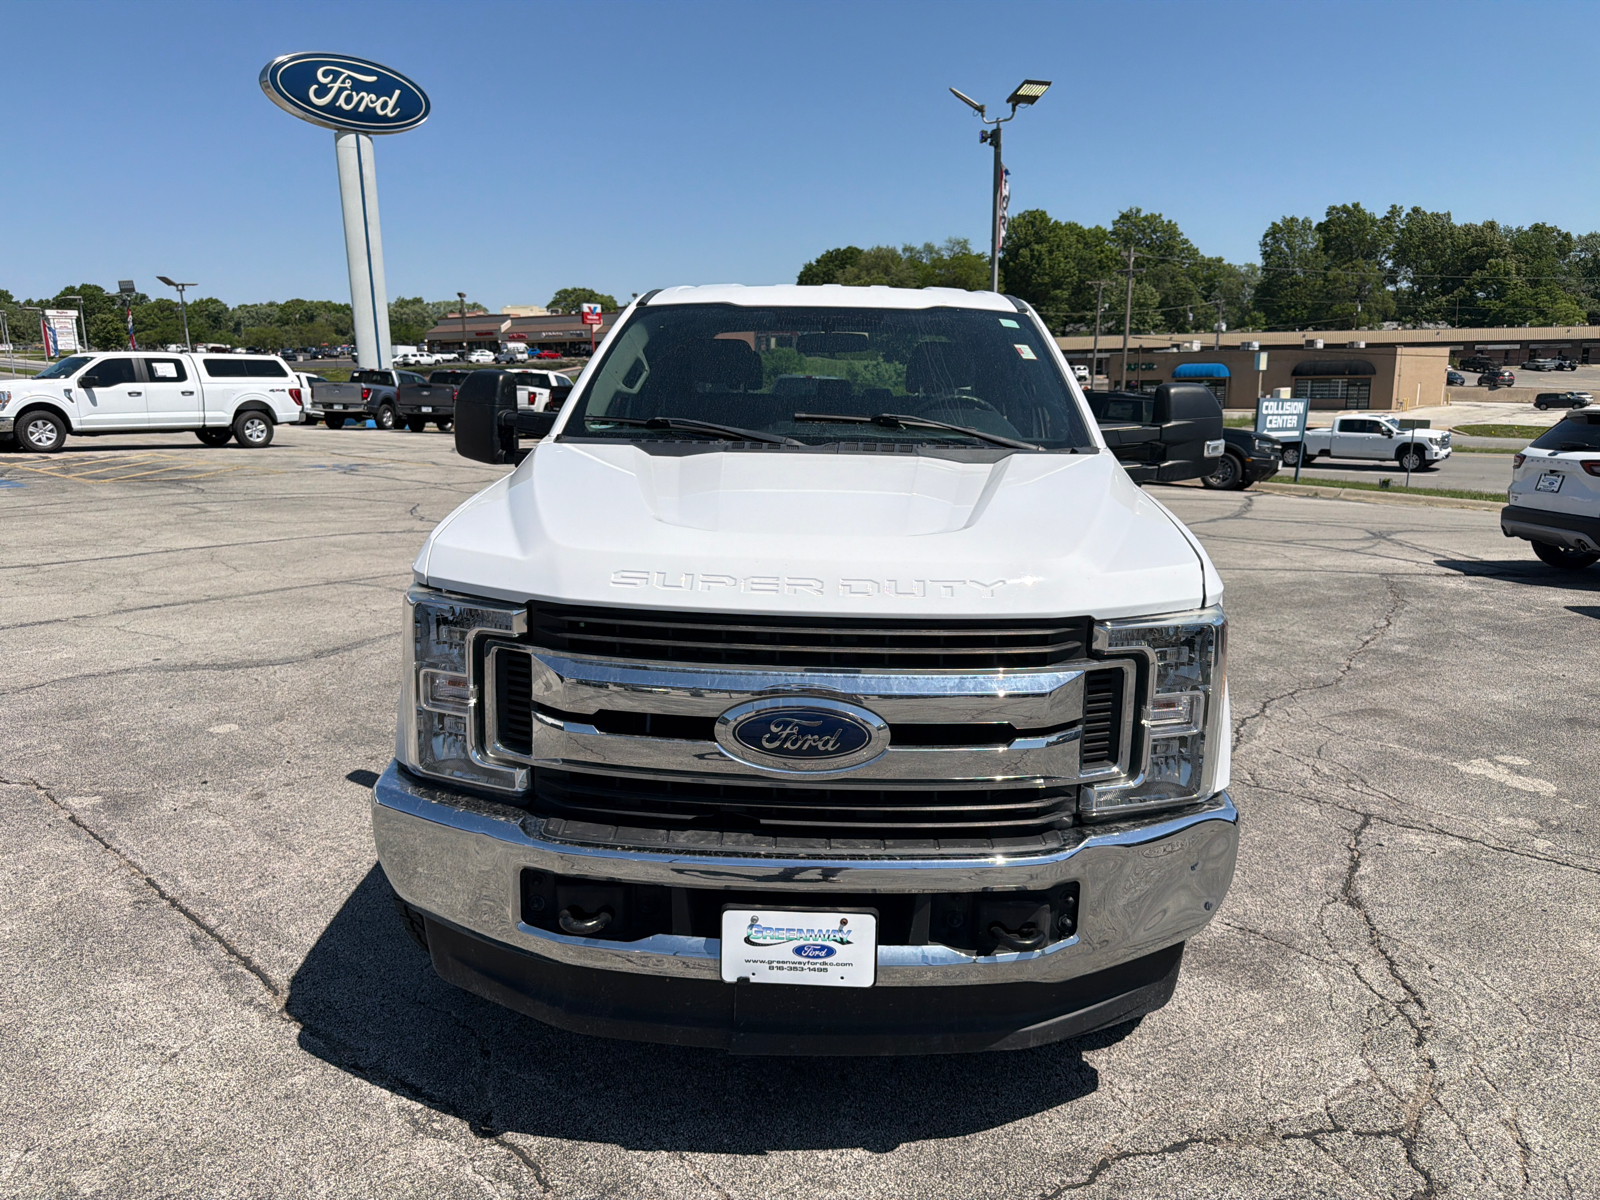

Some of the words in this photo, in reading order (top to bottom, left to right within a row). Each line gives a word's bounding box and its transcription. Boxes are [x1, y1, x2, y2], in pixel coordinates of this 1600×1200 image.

[308, 65, 401, 118] Ford
[1121, 362, 1155, 371] APOR
[1262, 401, 1304, 414] COLLISION
[1266, 415, 1298, 428] CENTER
[609, 569, 825, 596] SUPER
[838, 578, 1007, 599] DUTY
[761, 717, 843, 751] Ford
[746, 923, 852, 943] GREENWAY
[801, 945, 828, 957] Ford
[744, 958, 854, 967] www.greenwayfordkc.com
[768, 965, 829, 973] 816-353-1495
